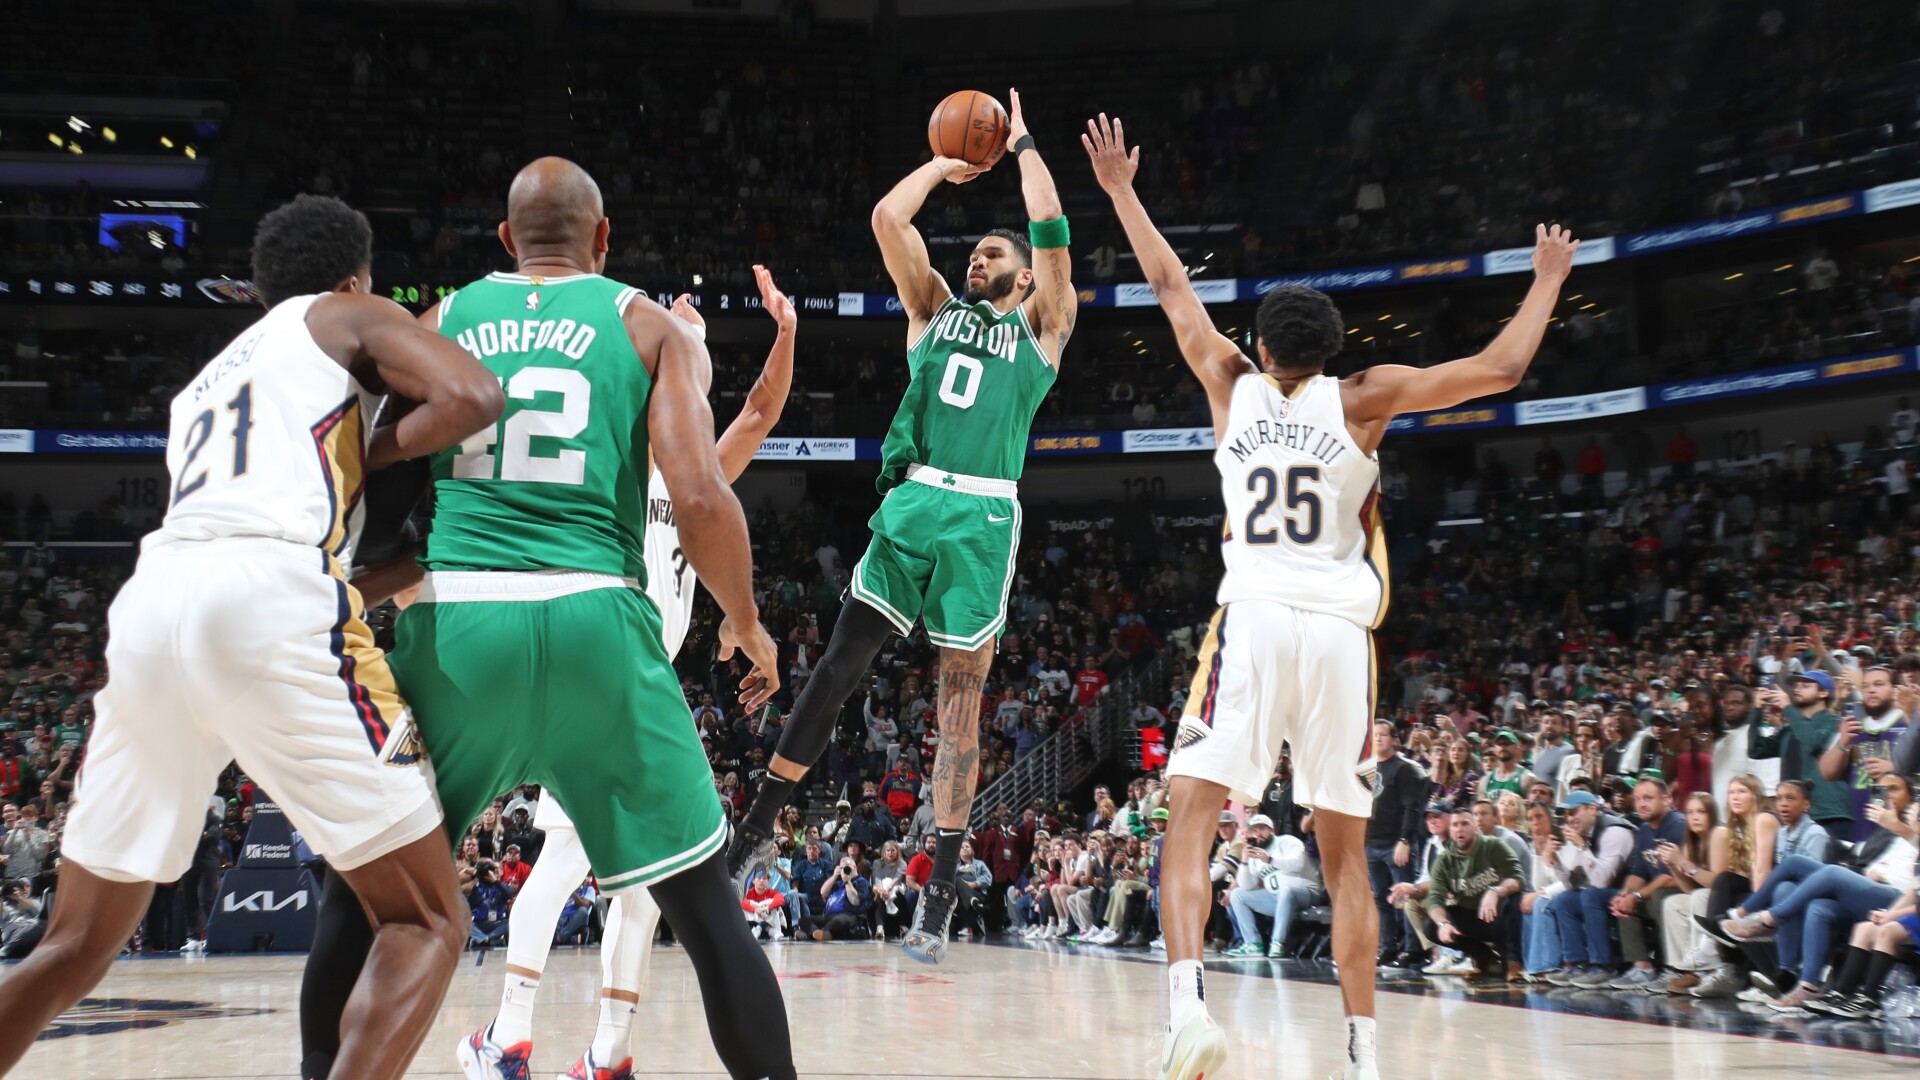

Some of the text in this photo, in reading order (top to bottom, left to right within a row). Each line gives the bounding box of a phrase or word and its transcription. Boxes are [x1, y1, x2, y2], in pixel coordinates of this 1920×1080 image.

[392, 286, 419, 303] 2.0
[721, 295, 728, 308] 2
[804, 297, 834, 309] FOULS
[456, 318, 597, 361] HORFORD
[931, 309, 1020, 363] BOSTON
[194, 332, 264, 402] MISSI
[938, 352, 984, 410] 0
[171, 375, 256, 508] 21
[813, 441, 849, 449] ANDREWS
[1228, 419, 1347, 466] MURPHY III
[117, 477, 159, 506] 118
[1245, 465, 1323, 546] 25
[671, 547, 688, 598] 3
[262, 844, 292, 852] Keesler
[262, 851, 291, 859] Federal
[1269, 874, 1279, 891] 0
[223, 890, 308, 912] KIA
